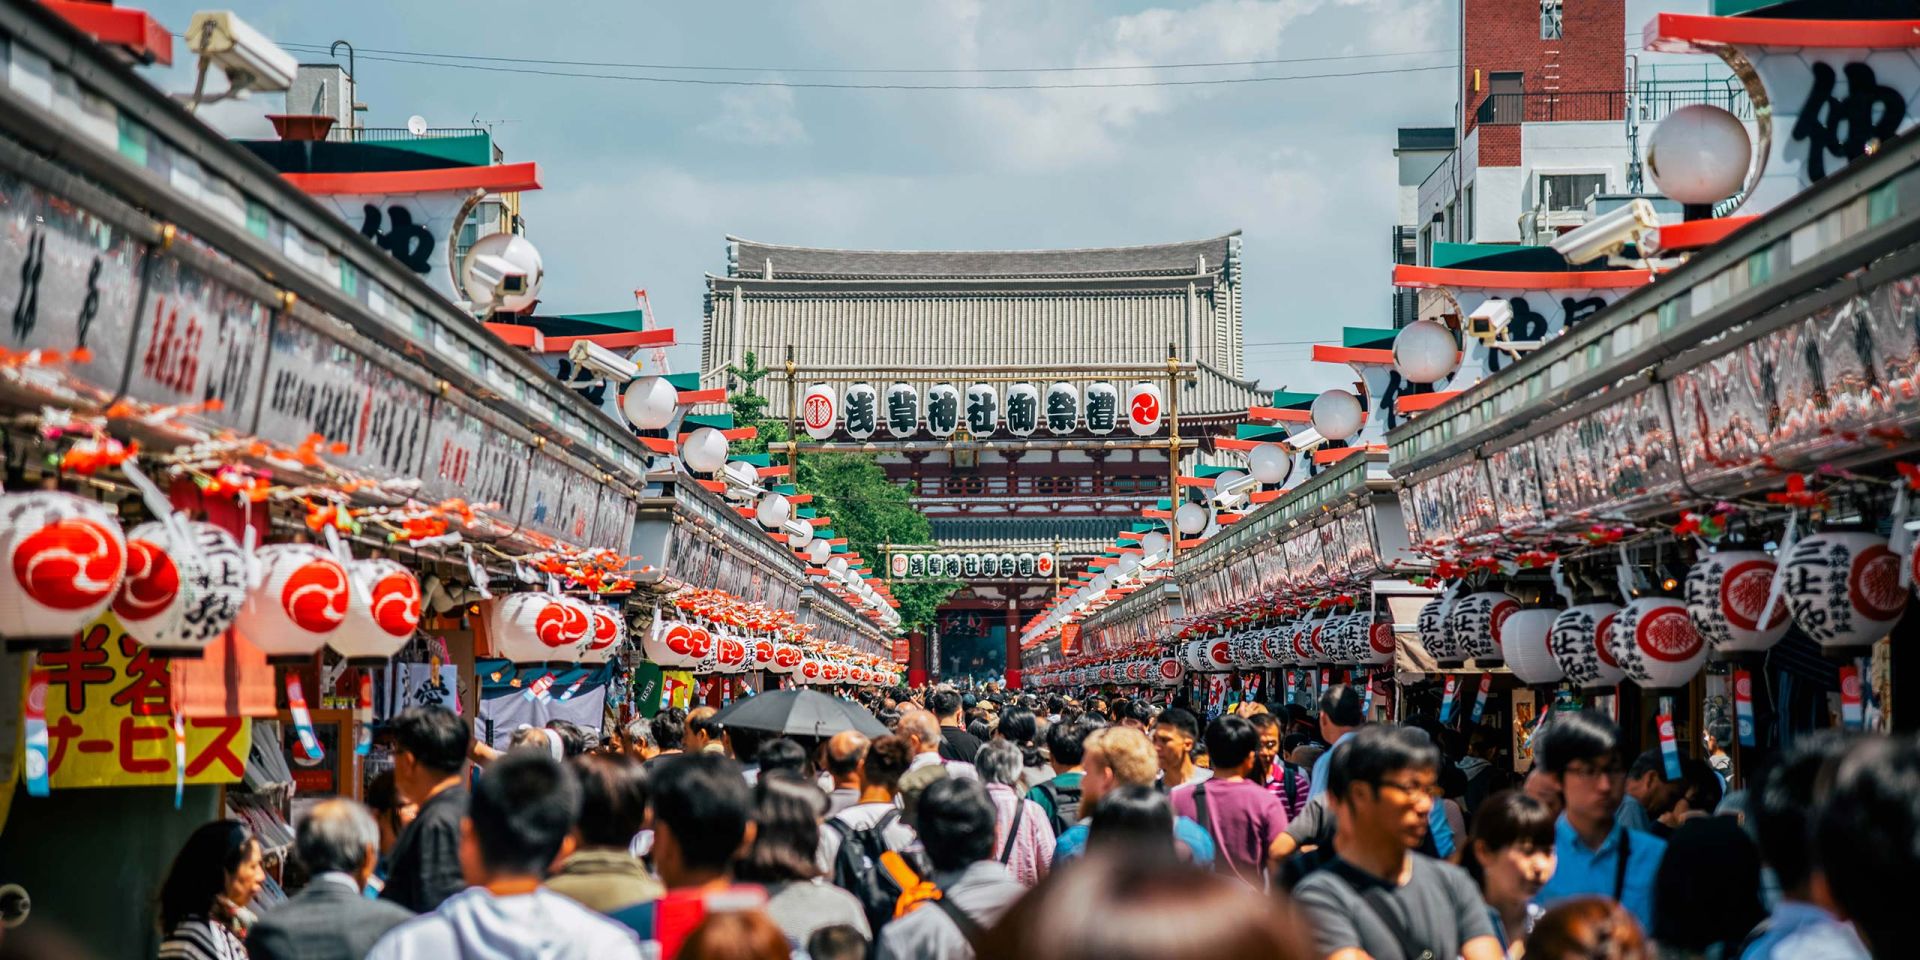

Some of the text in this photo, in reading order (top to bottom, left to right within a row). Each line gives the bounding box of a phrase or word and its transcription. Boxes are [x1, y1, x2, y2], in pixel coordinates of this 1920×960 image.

[846, 390, 1117, 433] 浅草神社御祭禮
